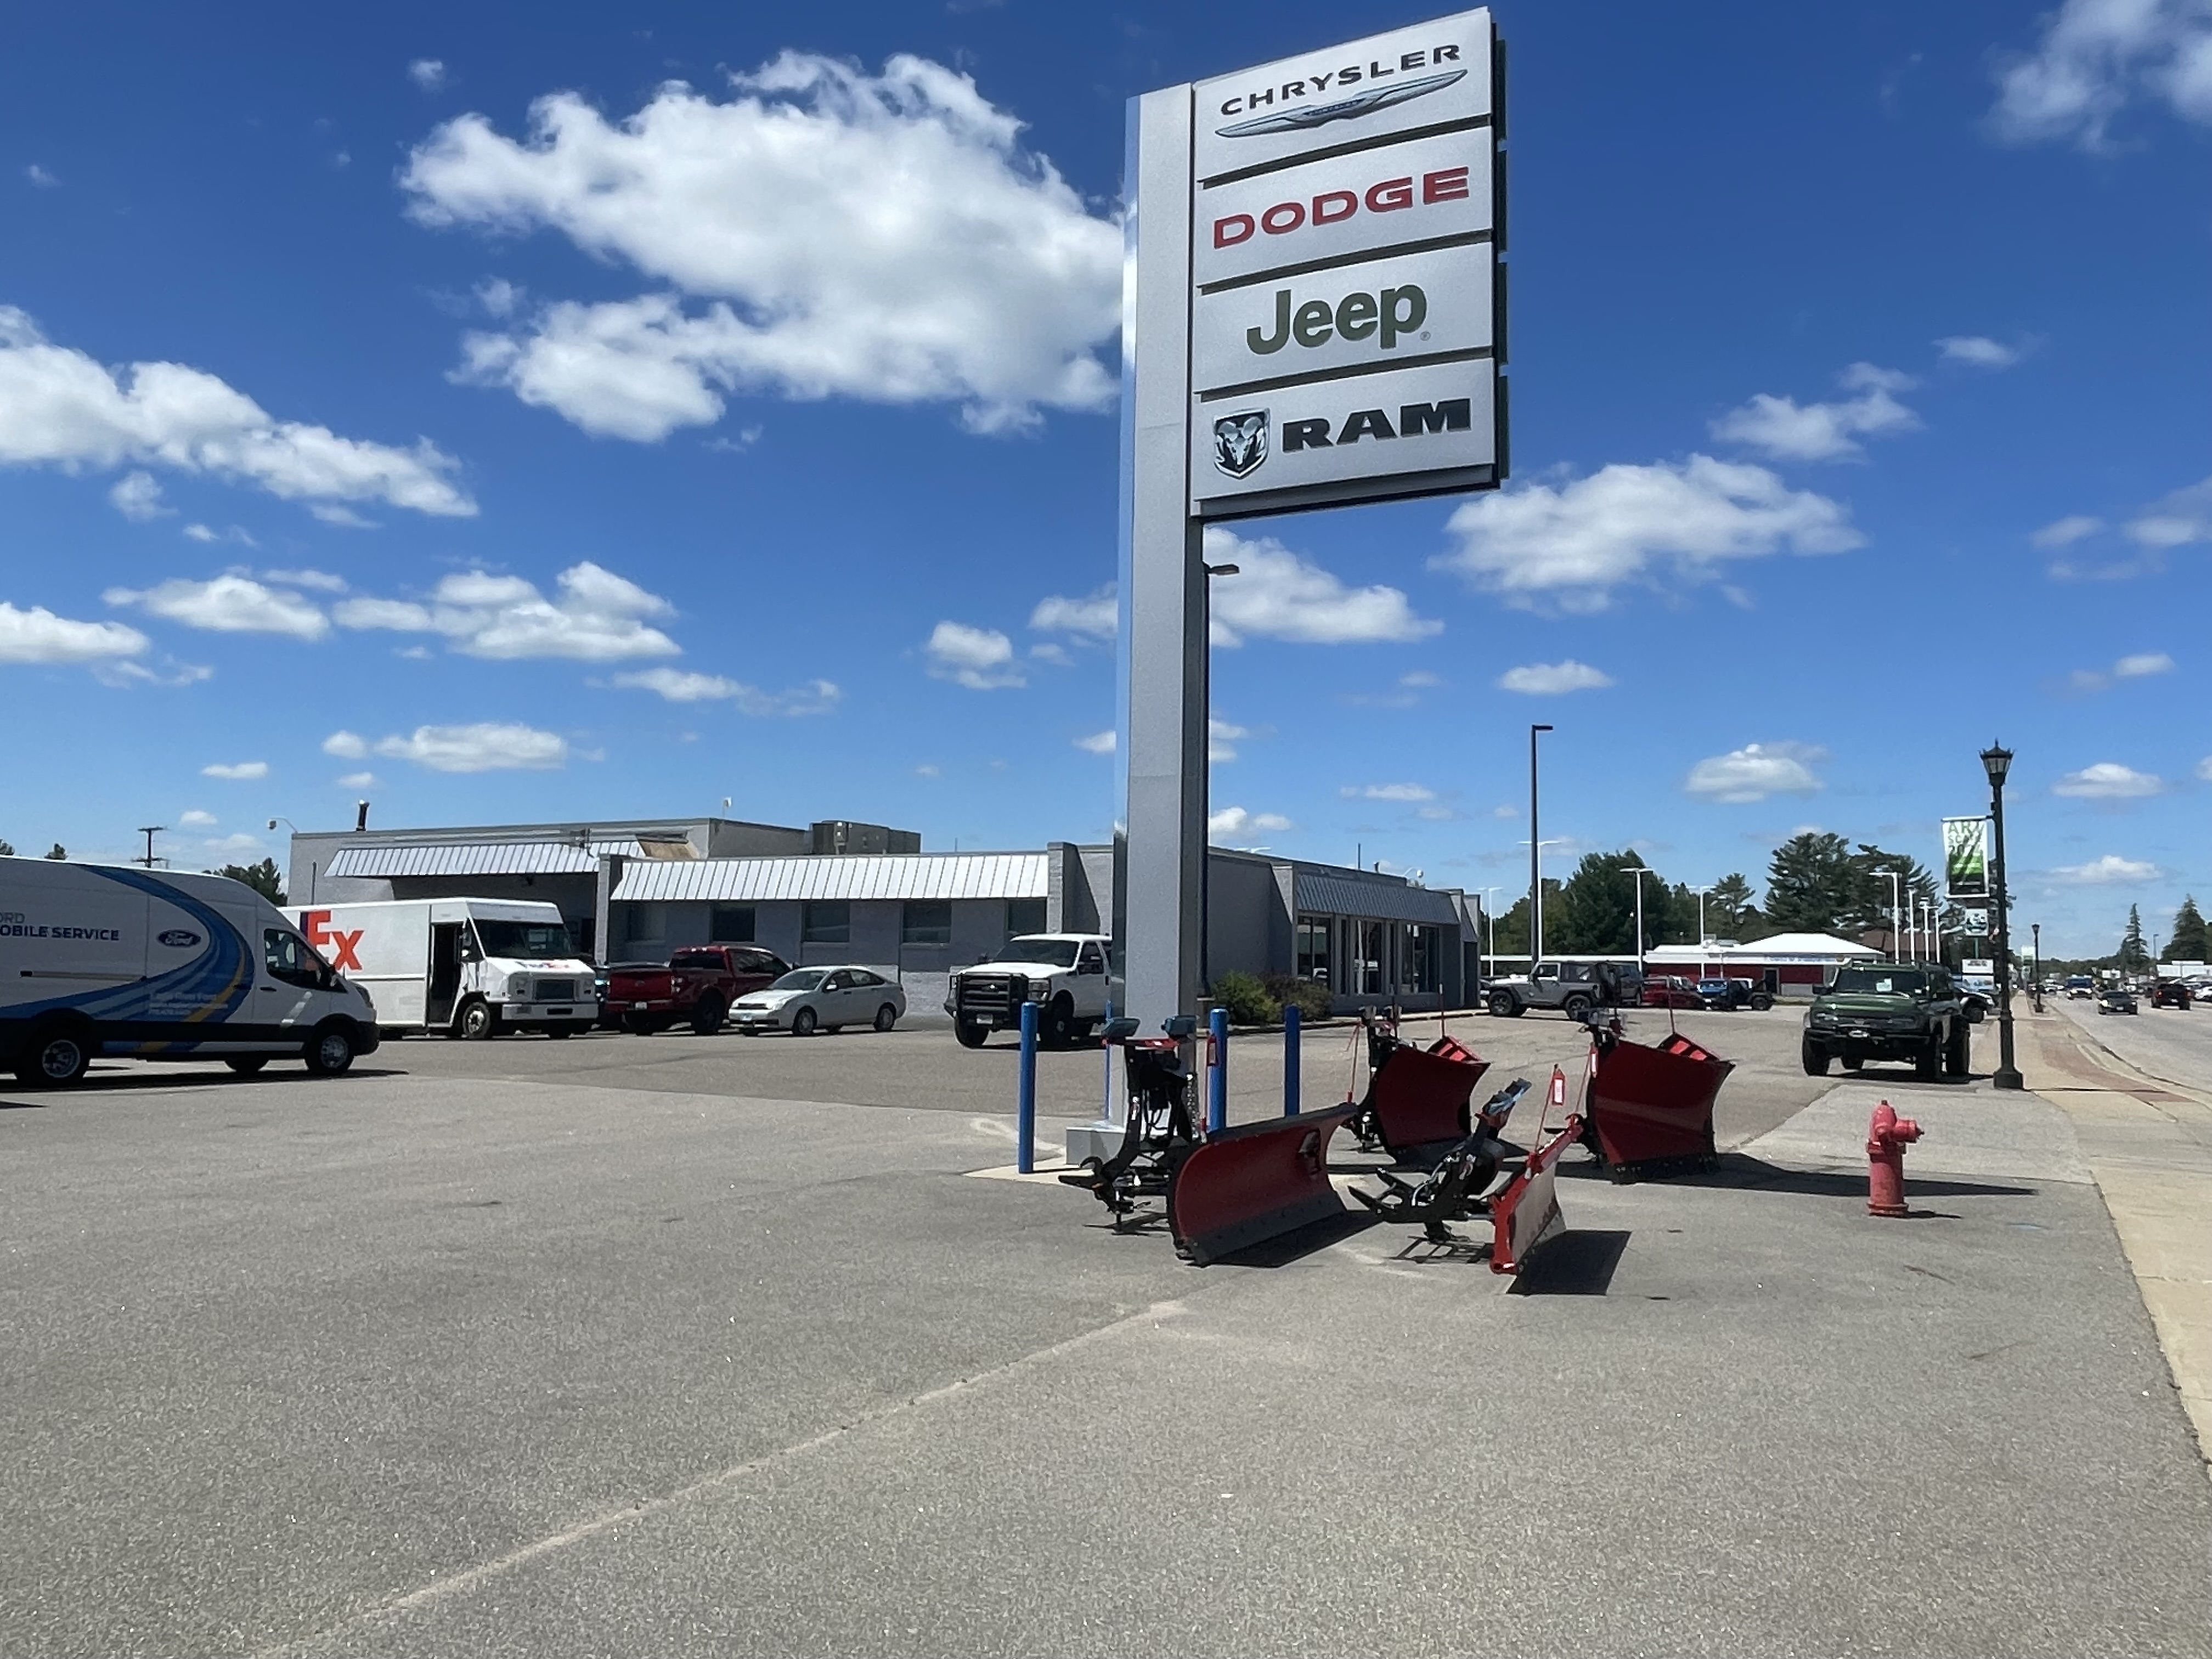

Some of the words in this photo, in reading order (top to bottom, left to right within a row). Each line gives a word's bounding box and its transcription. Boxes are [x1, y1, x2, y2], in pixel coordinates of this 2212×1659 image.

[1220, 44, 1461, 115] CHRYSLER
[1214, 166, 1469, 250] DODGE
[1246, 284, 1427, 355] Jeep
[1283, 398, 1471, 453] RAM
[0, 912, 25, 924] RD
[51, 927, 120, 941] SERVICE
[300, 910, 364, 970] Ex
